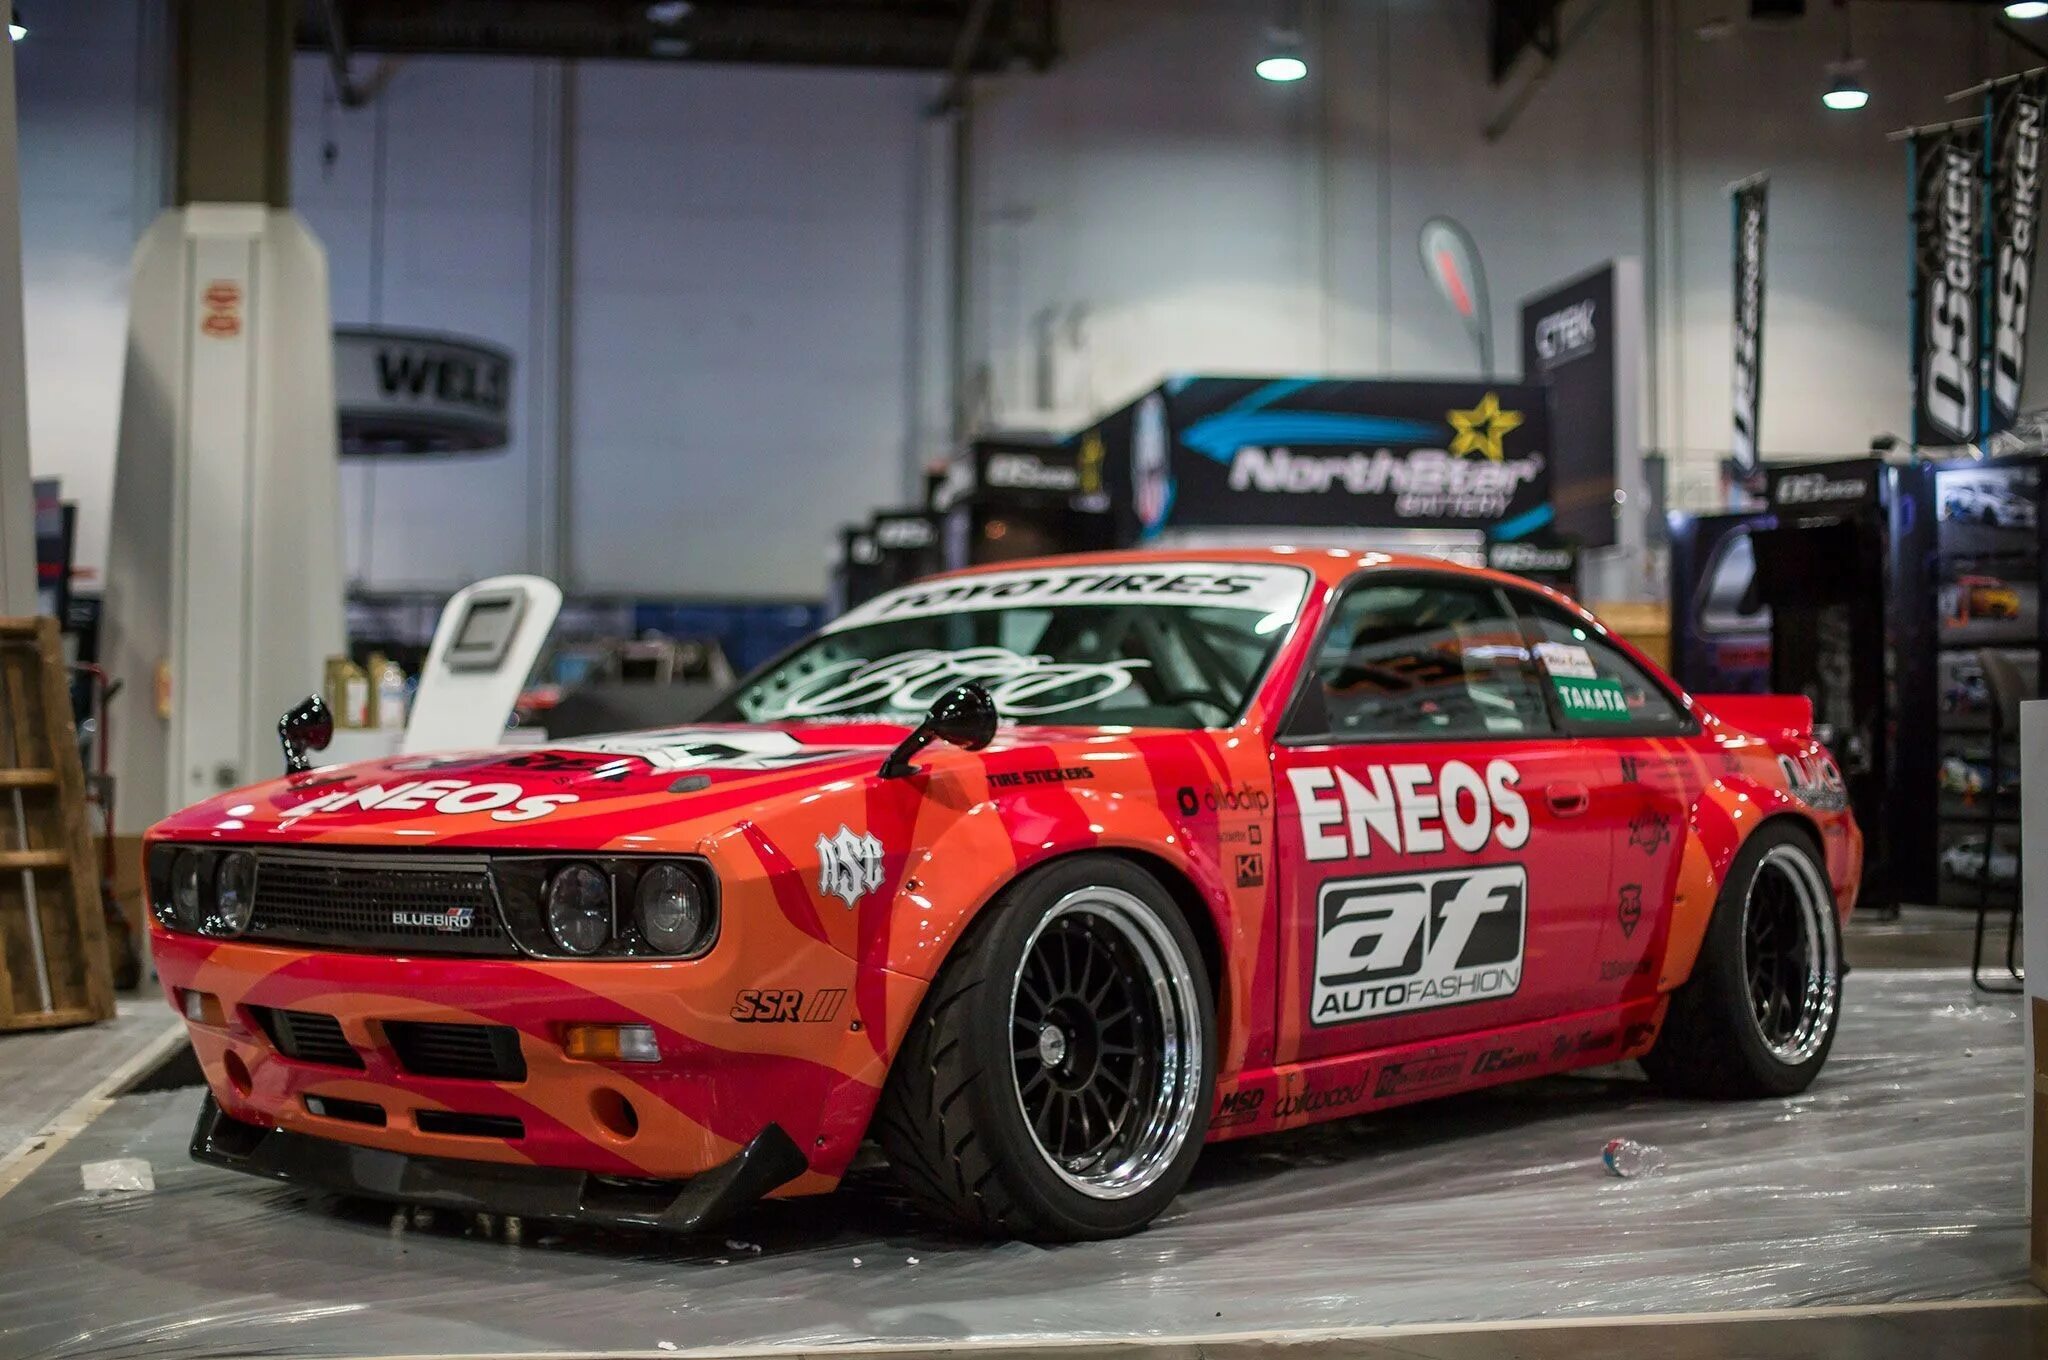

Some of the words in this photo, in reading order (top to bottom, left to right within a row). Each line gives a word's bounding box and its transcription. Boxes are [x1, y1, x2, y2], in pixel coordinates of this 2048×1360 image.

[1229, 447, 1536, 494] NorthStar
[879, 576, 1050, 617] TOYO
[1051, 573, 1266, 597] TIRES
[1558, 685, 1628, 713] TAKATA
[985, 771, 1022, 787] TIRE
[1022, 766, 1095, 785] STICKERS
[278, 779, 580, 829] ENEOS
[1286, 758, 1531, 862] ENEOS
[392, 911, 471, 928] BLUEBIRD
[730, 989, 804, 1023] SSR
[1220, 1086, 1265, 1115] MSD
